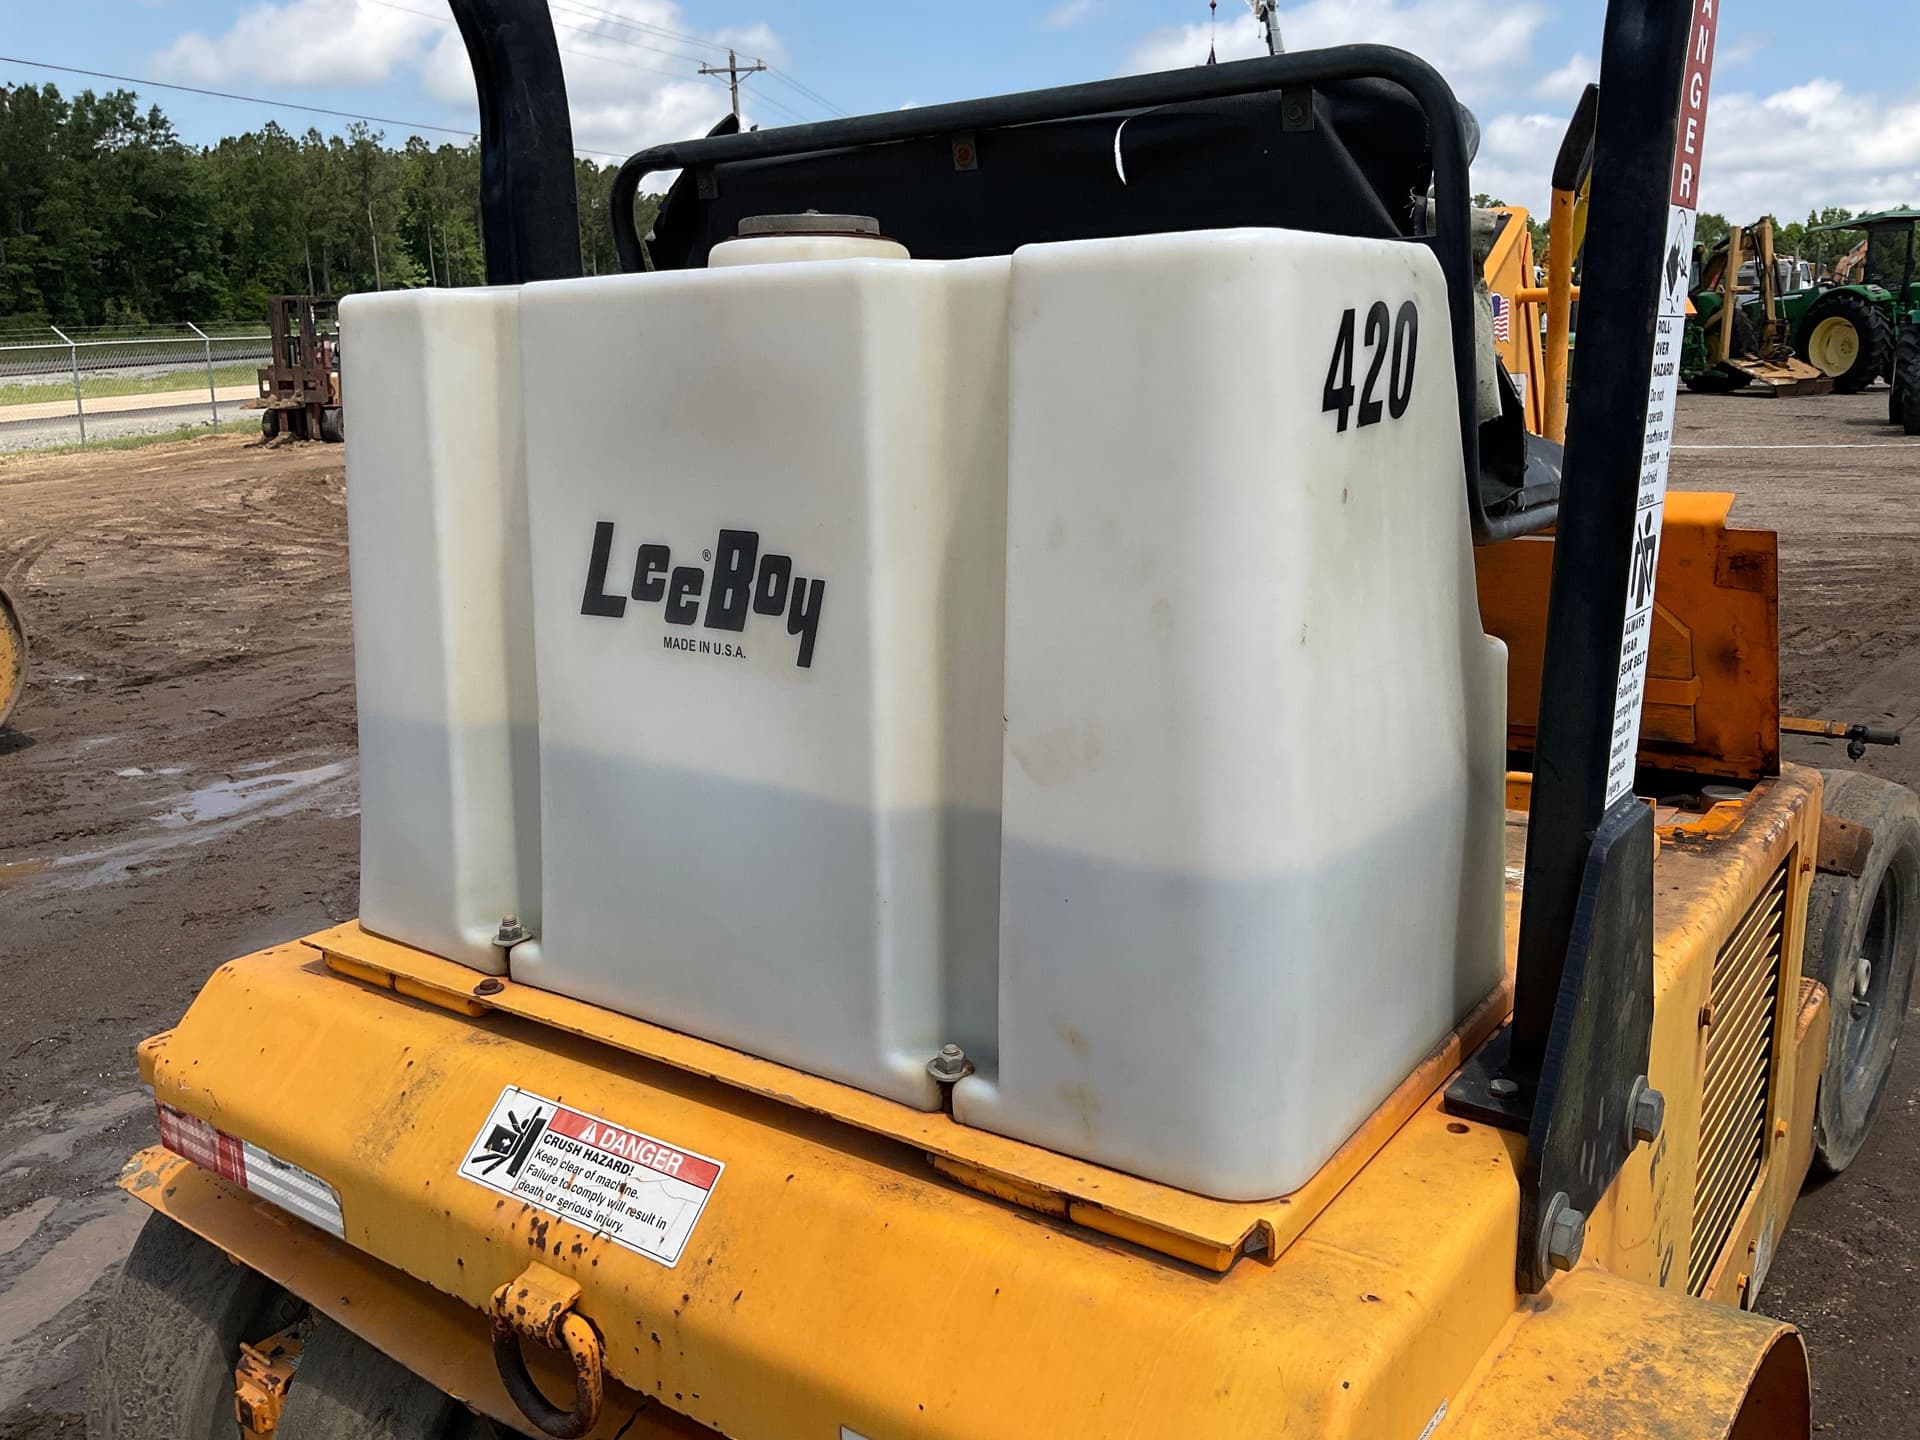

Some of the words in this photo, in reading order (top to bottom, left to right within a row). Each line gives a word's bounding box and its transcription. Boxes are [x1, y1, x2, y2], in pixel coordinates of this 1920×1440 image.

[1322, 300, 1418, 433] 420
[1655, 342, 1670, 356] OVER
[581, 521, 825, 668] LeeBoy
[663, 637, 696, 651] MADE
[700, 641, 710, 654] IN
[713, 643, 746, 659] U.S.A.
[1622, 636, 1638, 656] WEAR
[1624, 613, 1646, 637] ALWAYS
[1620, 658, 1634, 676] SEAT
[1633, 650, 1646, 669] BELT
[534, 1148, 559, 1168] Keep
[559, 1159, 585, 1176] clear
[584, 1169, 598, 1182] of
[595, 1174, 640, 1200] machne.
[543, 1133, 583, 1157] CRUSH
[582, 1148, 635, 1177] HAZARD!
[599, 1127, 684, 1176] DANGER
[517, 1178, 545, 1198] death
[544, 1192, 558, 1204] or
[556, 1196, 594, 1219] serious
[592, 1210, 624, 1234] injury.
[525, 1163, 559, 1185] Failure
[558, 1177, 568, 1190] to
[570, 1182, 606, 1206] comply
[606, 1198, 626, 1214] will
[625, 1204, 658, 1226] result
[655, 1215, 669, 1231] in
